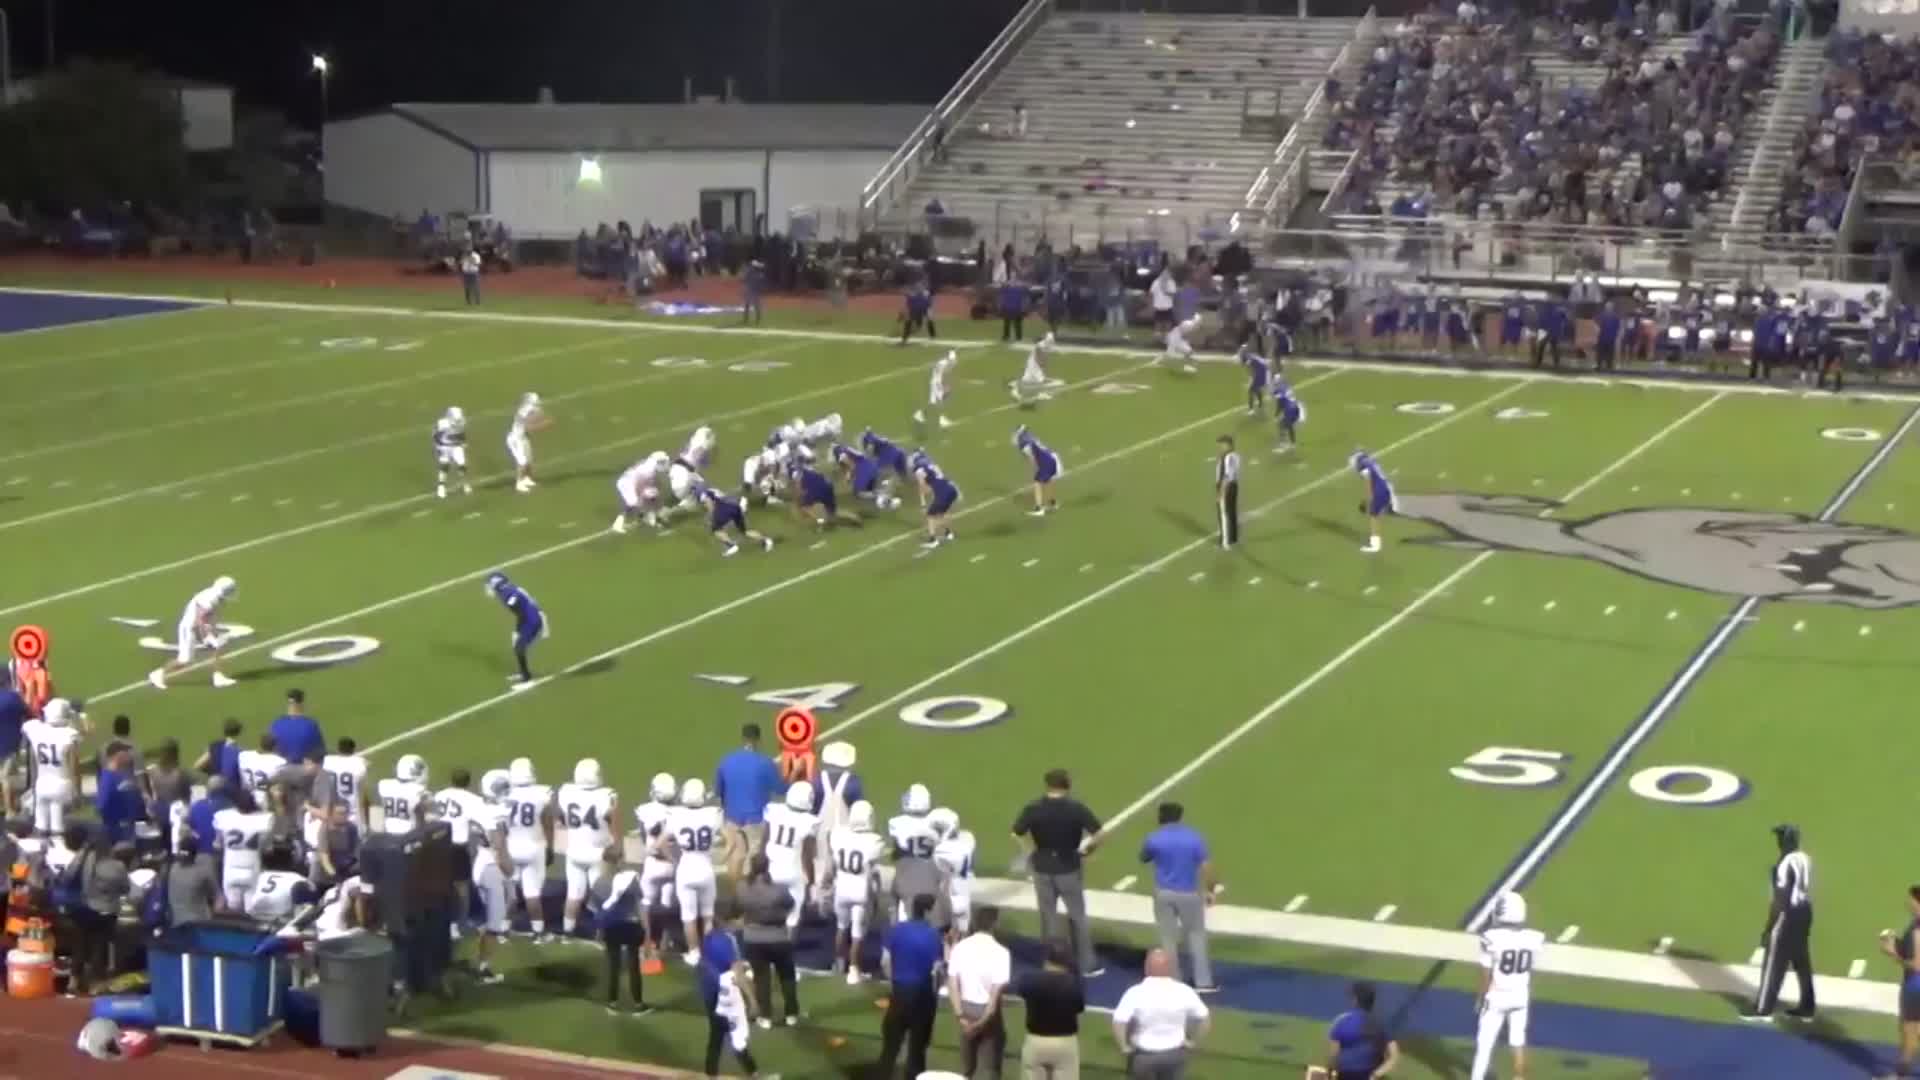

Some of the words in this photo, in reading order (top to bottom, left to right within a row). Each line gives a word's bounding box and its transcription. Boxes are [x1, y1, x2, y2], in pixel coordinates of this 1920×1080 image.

[36, 743, 62, 767] 61
[506, 800, 535, 828] 78
[566, 802, 601, 831] 64
[679, 824, 713, 852] 38
[775, 823, 796, 849] 11
[837, 847, 864, 876] 10
[260, 874, 282, 895] 5
[1498, 948, 1533, 976] 80
